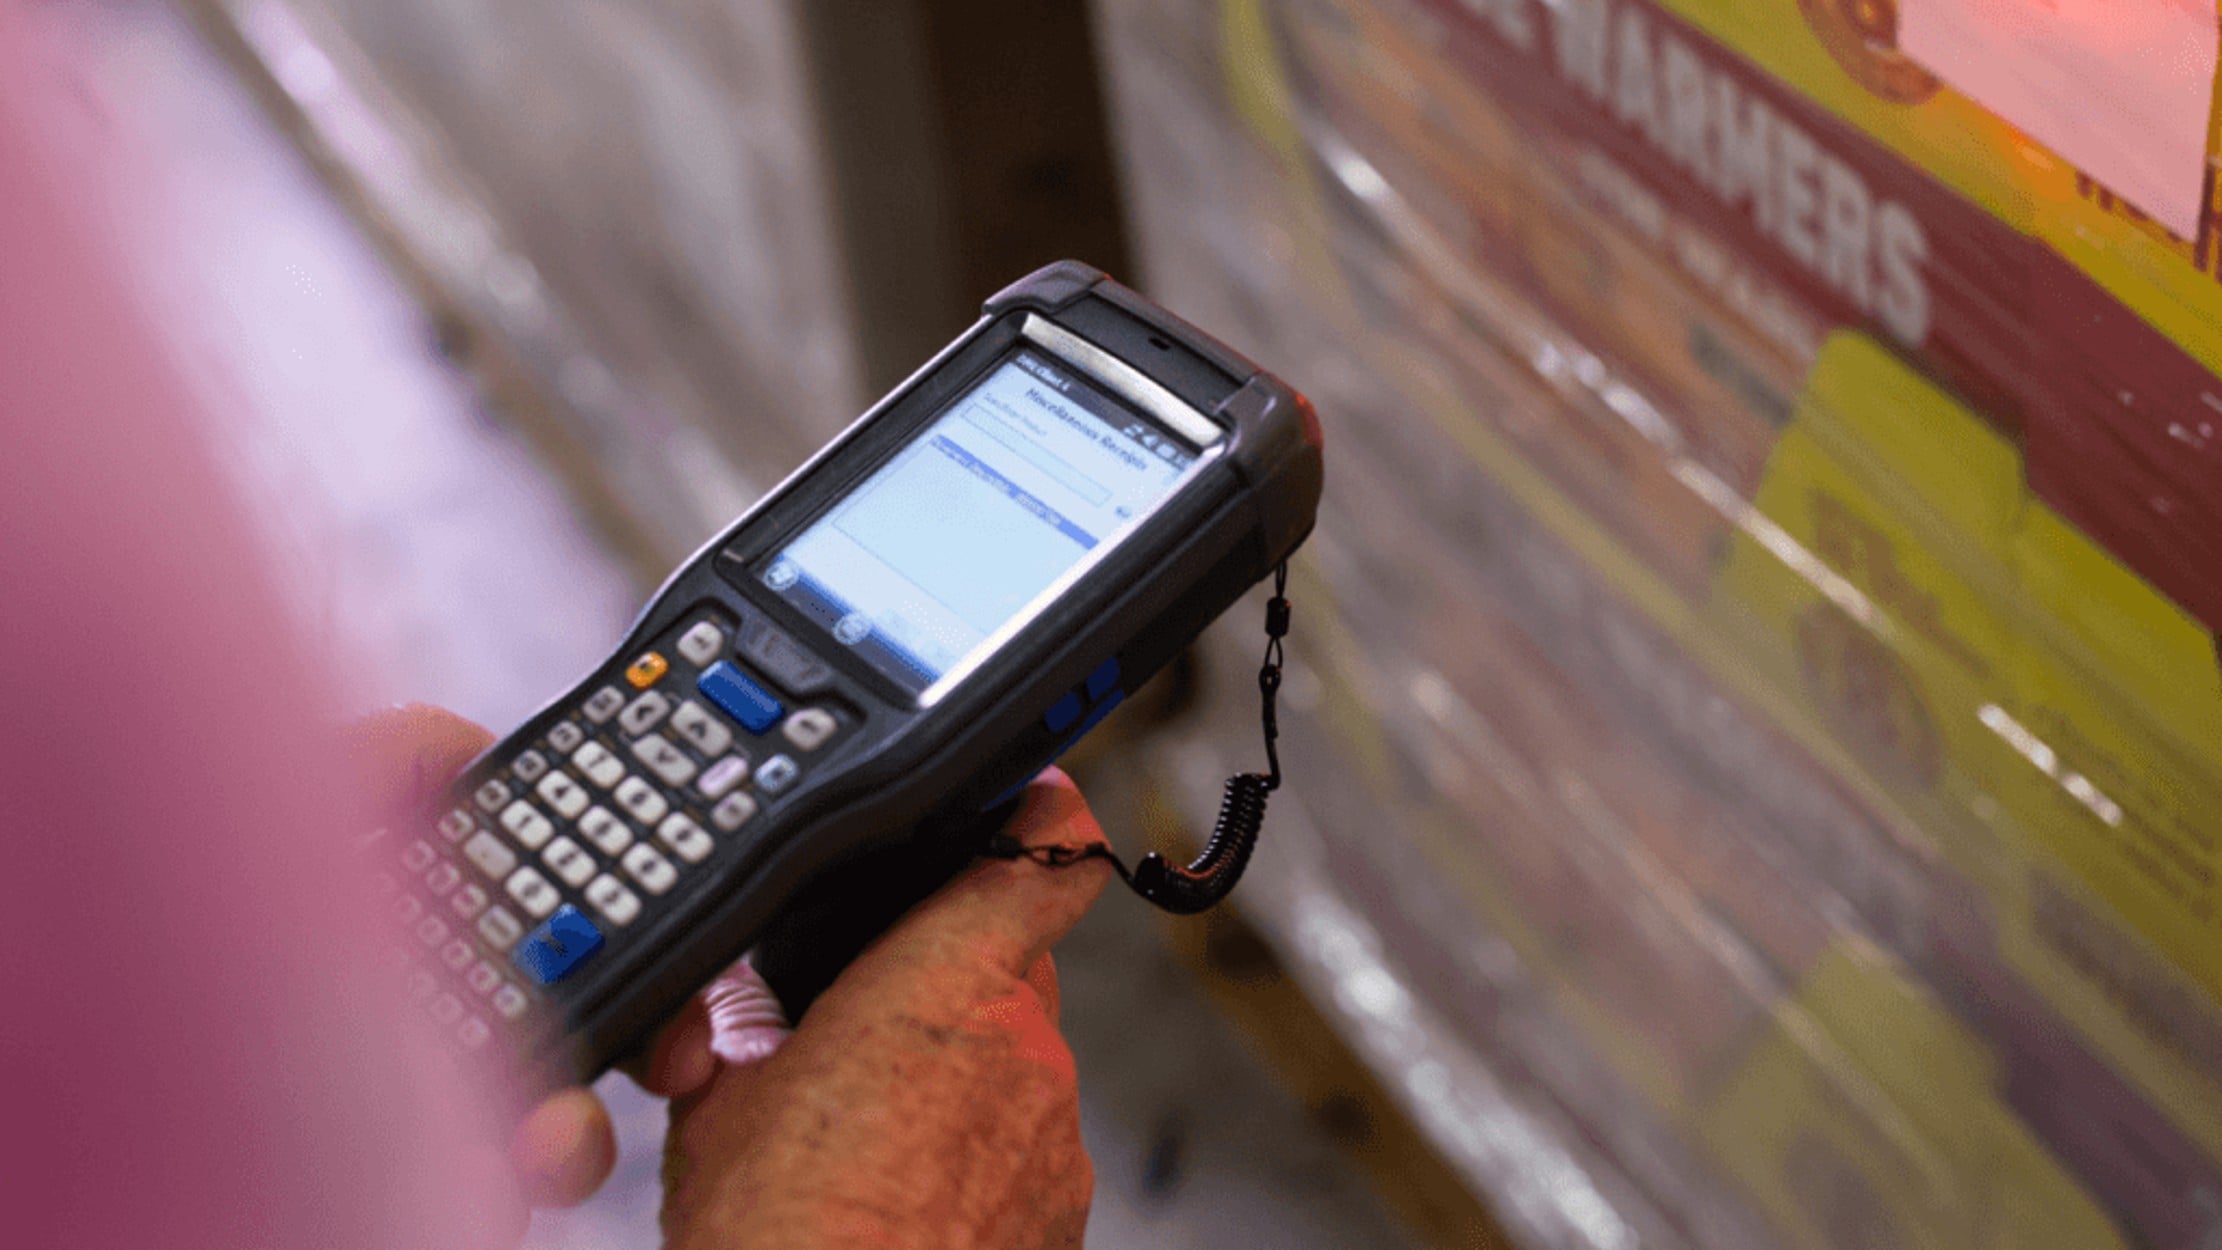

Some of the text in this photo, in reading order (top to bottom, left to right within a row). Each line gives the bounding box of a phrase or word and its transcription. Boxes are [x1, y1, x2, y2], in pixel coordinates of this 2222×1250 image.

[1541, 0, 1931, 347] WARMERS
[1025, 387, 1147, 470] Miscellaneous Receipts
